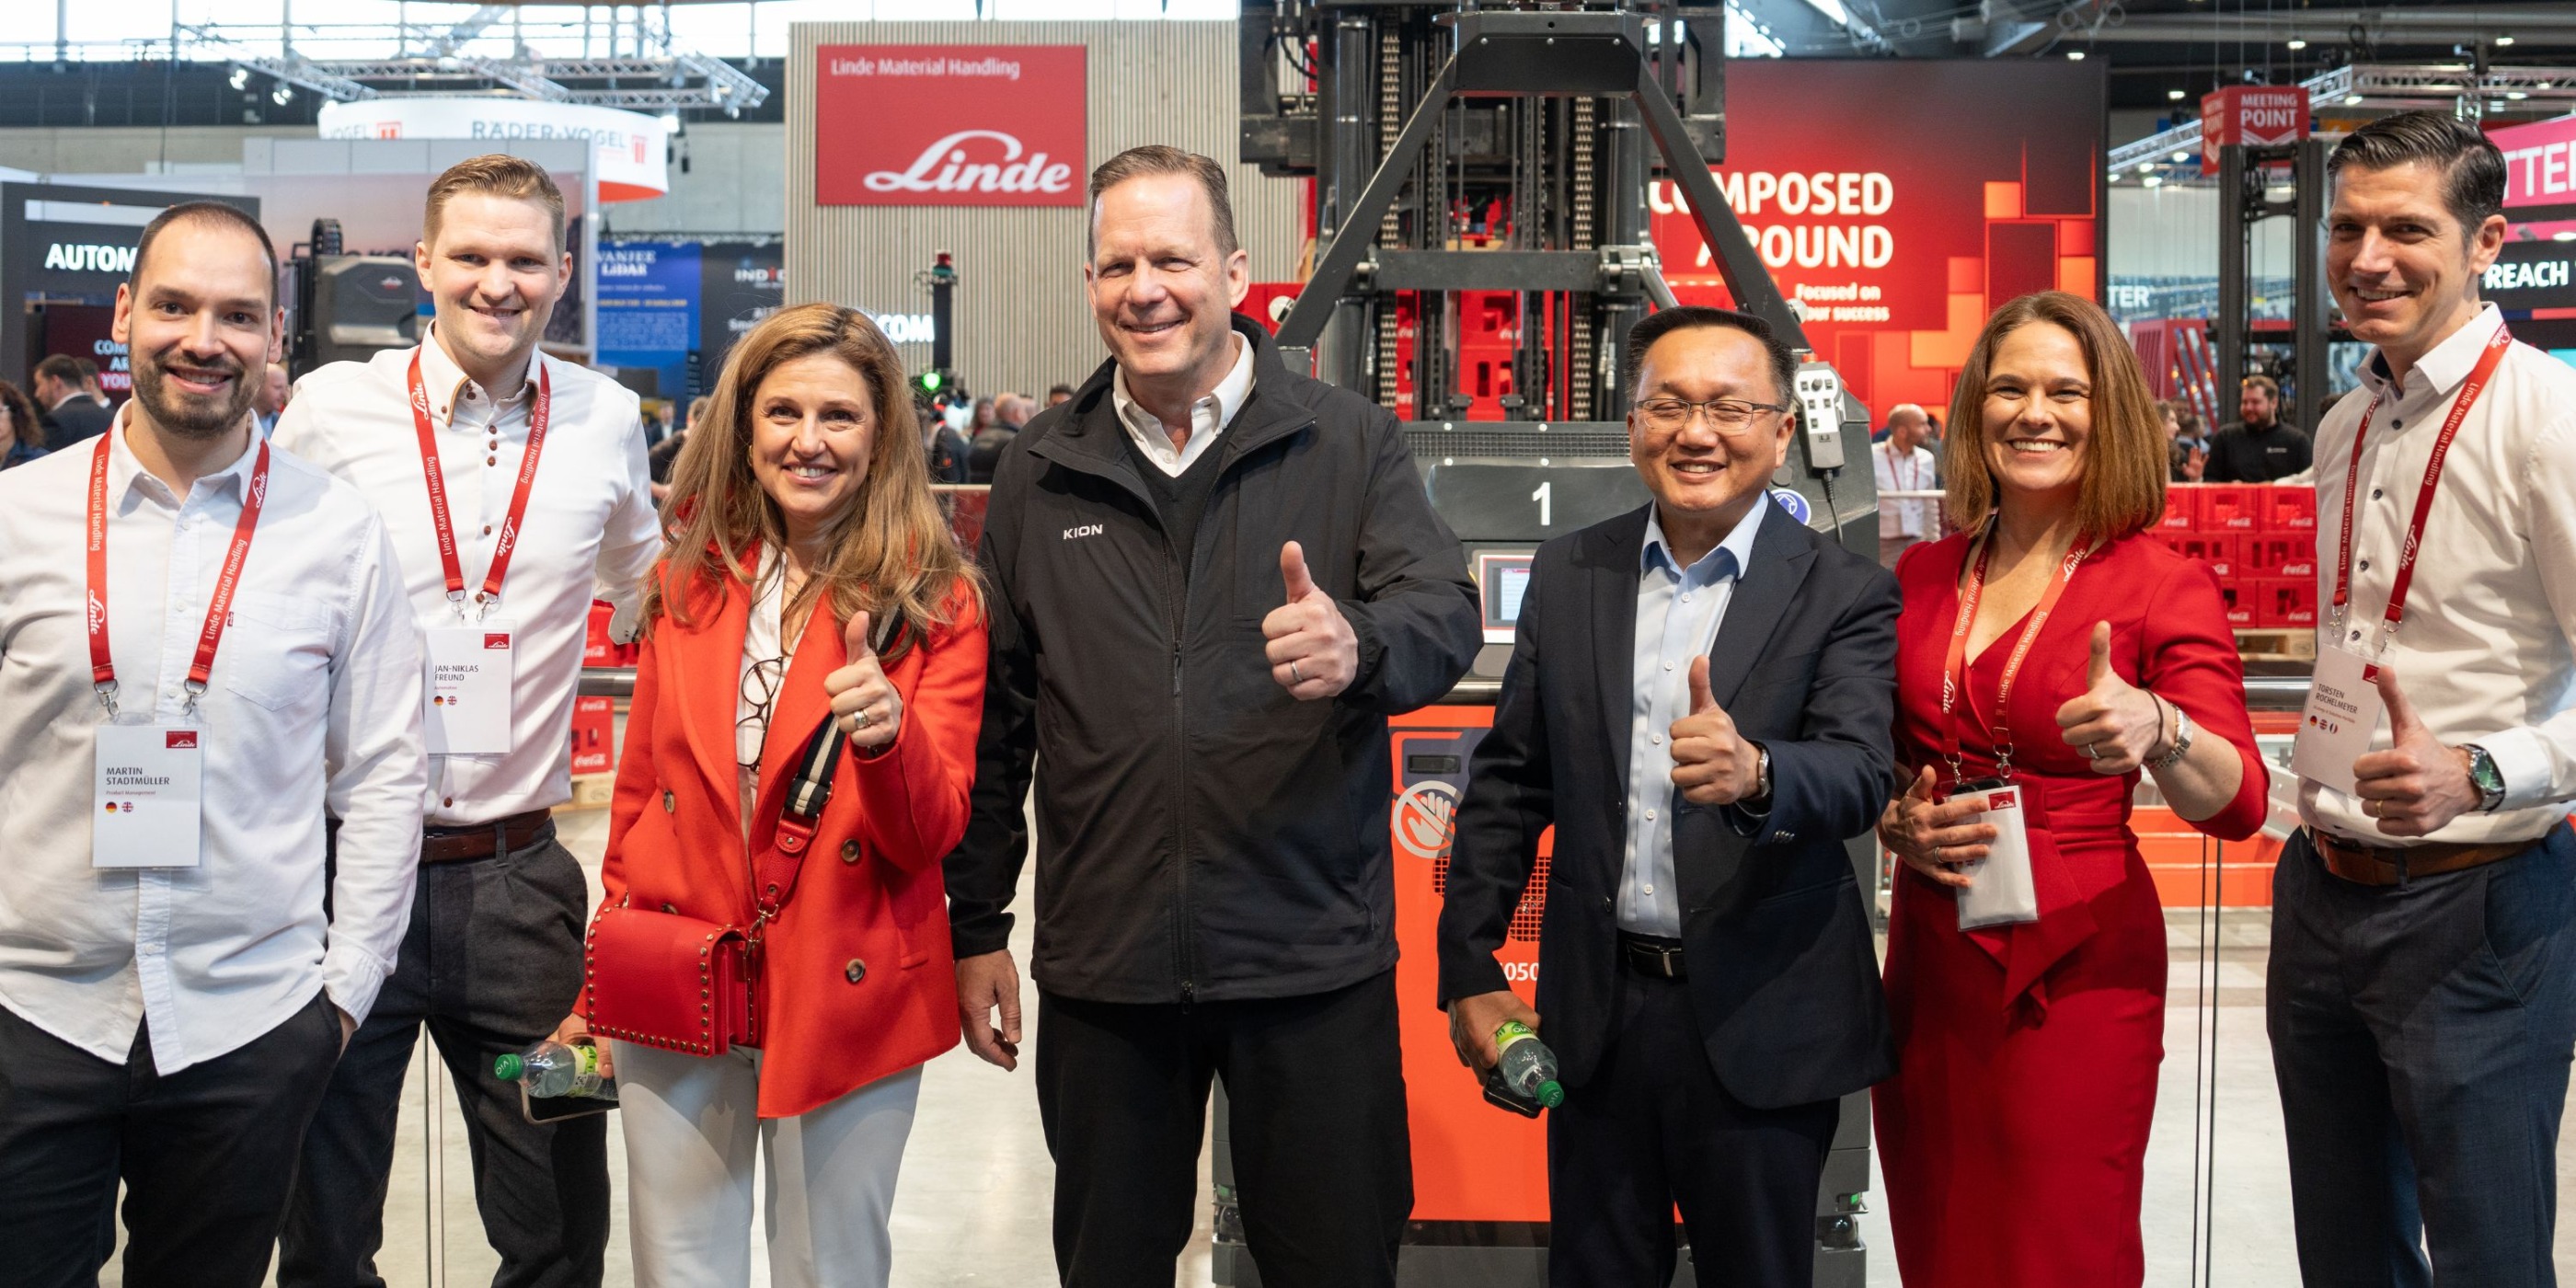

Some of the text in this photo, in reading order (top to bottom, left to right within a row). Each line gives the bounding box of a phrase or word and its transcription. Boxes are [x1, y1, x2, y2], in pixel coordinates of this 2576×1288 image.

[831, 58, 1020, 80] Linde Material Handling
[2240, 109, 2298, 128] POINT
[2241, 94, 2298, 108] MEETING
[863, 130, 1072, 193] Linde
[1696, 224, 1894, 269] OUND
[2485, 260, 2570, 290] REACH
[1806, 305, 1831, 322] our
[410, 380, 430, 420] Linde
[521, 393, 548, 484] Linde Material Handling
[2424, 382, 2479, 486] Linde Material Handling
[89, 454, 106, 552] Linde Material Handling
[426, 456, 453, 556] Linde Material Handling
[1532, 482, 1551, 526] 1
[497, 516, 515, 558] Linde
[1063, 524, 1103, 540] KION
[2062, 546, 2086, 583] Linde
[204, 539, 247, 640] Linde Material Handling
[88, 589, 106, 636] Linde
[1955, 600, 1976, 637] Handling
[434, 664, 479, 674] JAN-NIKLAS
[1998, 611, 2048, 704] Linde Material Handling
[434, 673, 465, 682] FREUND
[1942, 670, 1956, 715] Linde
[2318, 684, 2345, 699] TORSTEN
[2315, 692, 2358, 714] ROCHELMEYER
[106, 766, 143, 776] MARTIN
[106, 775, 170, 786] STADTMÜLLER
[1499, 961, 1539, 982] 050
